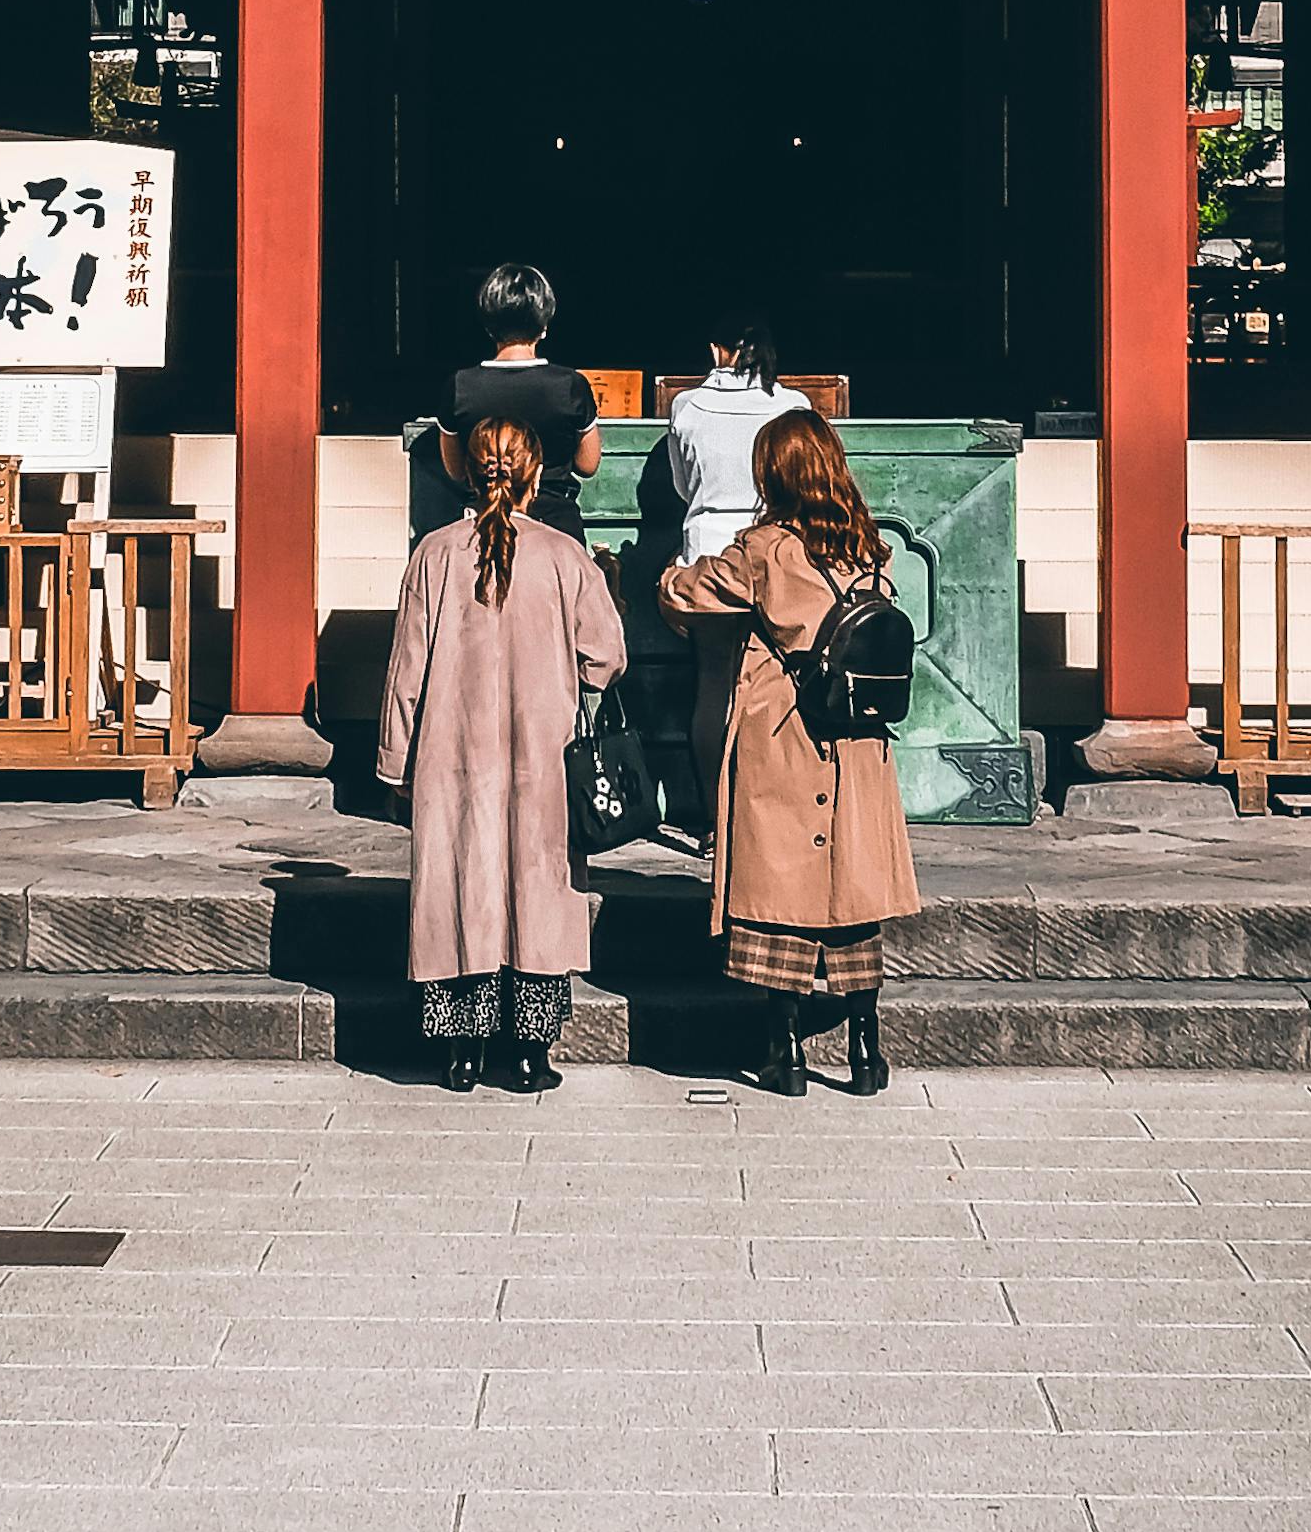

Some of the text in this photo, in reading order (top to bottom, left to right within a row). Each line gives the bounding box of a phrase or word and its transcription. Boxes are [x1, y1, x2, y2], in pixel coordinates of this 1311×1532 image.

[124, 169, 155, 308] 早期復興祈願
